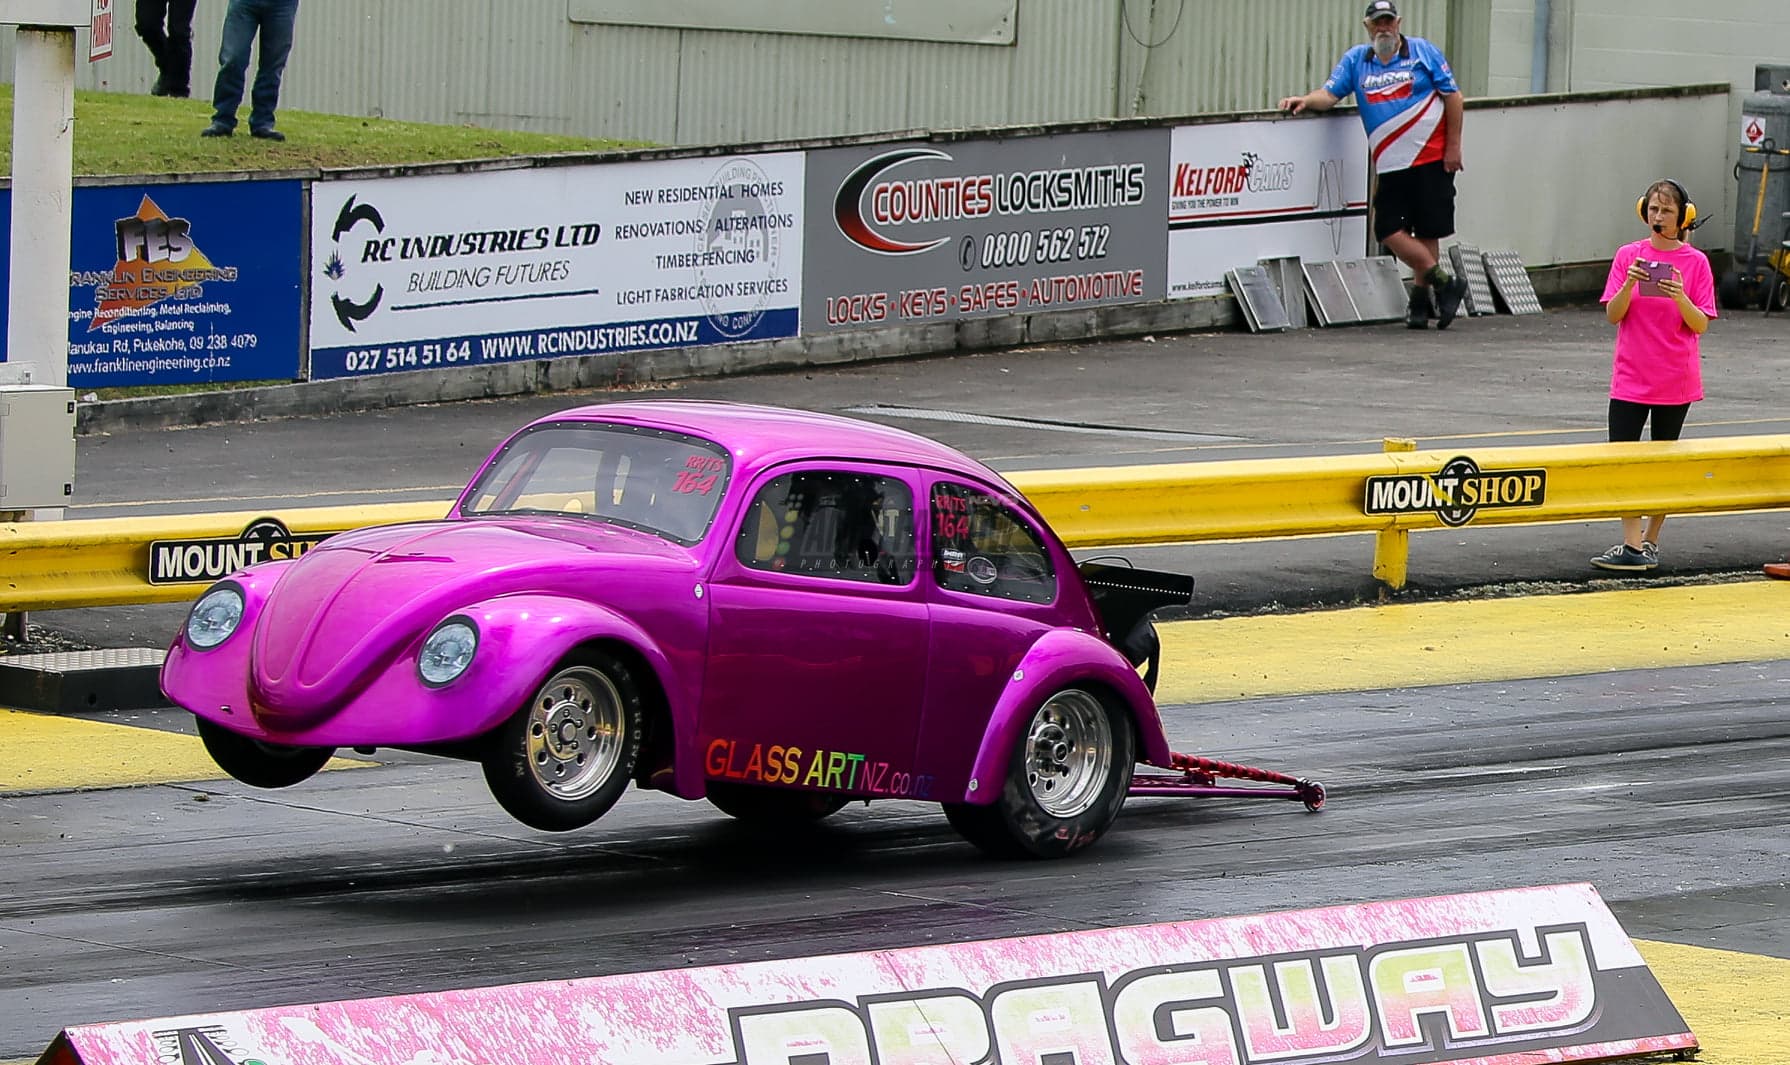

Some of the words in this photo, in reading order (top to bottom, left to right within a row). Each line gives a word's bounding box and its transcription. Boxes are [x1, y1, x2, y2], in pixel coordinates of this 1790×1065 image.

[1172, 162, 1247, 197] KELFORD
[1248, 158, 1295, 194] CAMS
[625, 190, 654, 206] NEW
[658, 184, 735, 204] RESIDENTIAL
[741, 181, 784, 199] HOMES
[872, 174, 993, 226] COUNTIES
[996, 164, 1145, 215] LOCKSMITHS
[116, 217, 192, 264] FES
[615, 219, 703, 240] RENOVATIONS
[714, 213, 793, 232] ALTERATIONS
[360, 237, 396, 264] RC
[400, 226, 549, 260] INDUSTRIES
[554, 223, 601, 248] LTD
[981, 231, 1032, 268] 0800
[1035, 227, 1075, 262] 562
[1078, 223, 1110, 259] 572
[656, 253, 699, 270] TIMBER
[702, 249, 755, 266] FENCING
[70, 269, 136, 287] RANKLIN
[407, 266, 492, 293] BUILDING
[495, 260, 571, 284] FUTURES
[617, 289, 652, 305] LIGHT
[655, 282, 734, 303] FABRICATION
[737, 278, 788, 296] SERVICES
[95, 285, 168, 302] SERVICES
[826, 292, 887, 325] LOCKS
[899, 287, 948, 317] KEYS
[958, 280, 1020, 313] SAFES
[1028, 269, 1144, 306] AUTOMOTIVE
[68, 308, 92, 322] ngine
[67, 341, 109, 355] anukau
[113, 339, 130, 354] Rd,
[134, 337, 187, 353] Pukekohe,
[190, 336, 204, 350] 09
[207, 334, 228, 350] 238
[231, 333, 257, 348] 4079
[345, 350, 380, 371] 027
[386, 347, 417, 369] 514
[672, 470, 719, 496] 164
[1371, 477, 1460, 510] MOUNT
[1461, 474, 1542, 506] SHOP
[936, 512, 970, 540] 164
[157, 542, 265, 579] MOUNT
[705, 738, 802, 785] GLASS
[729, 921, 1601, 1065] DRAGWAY
